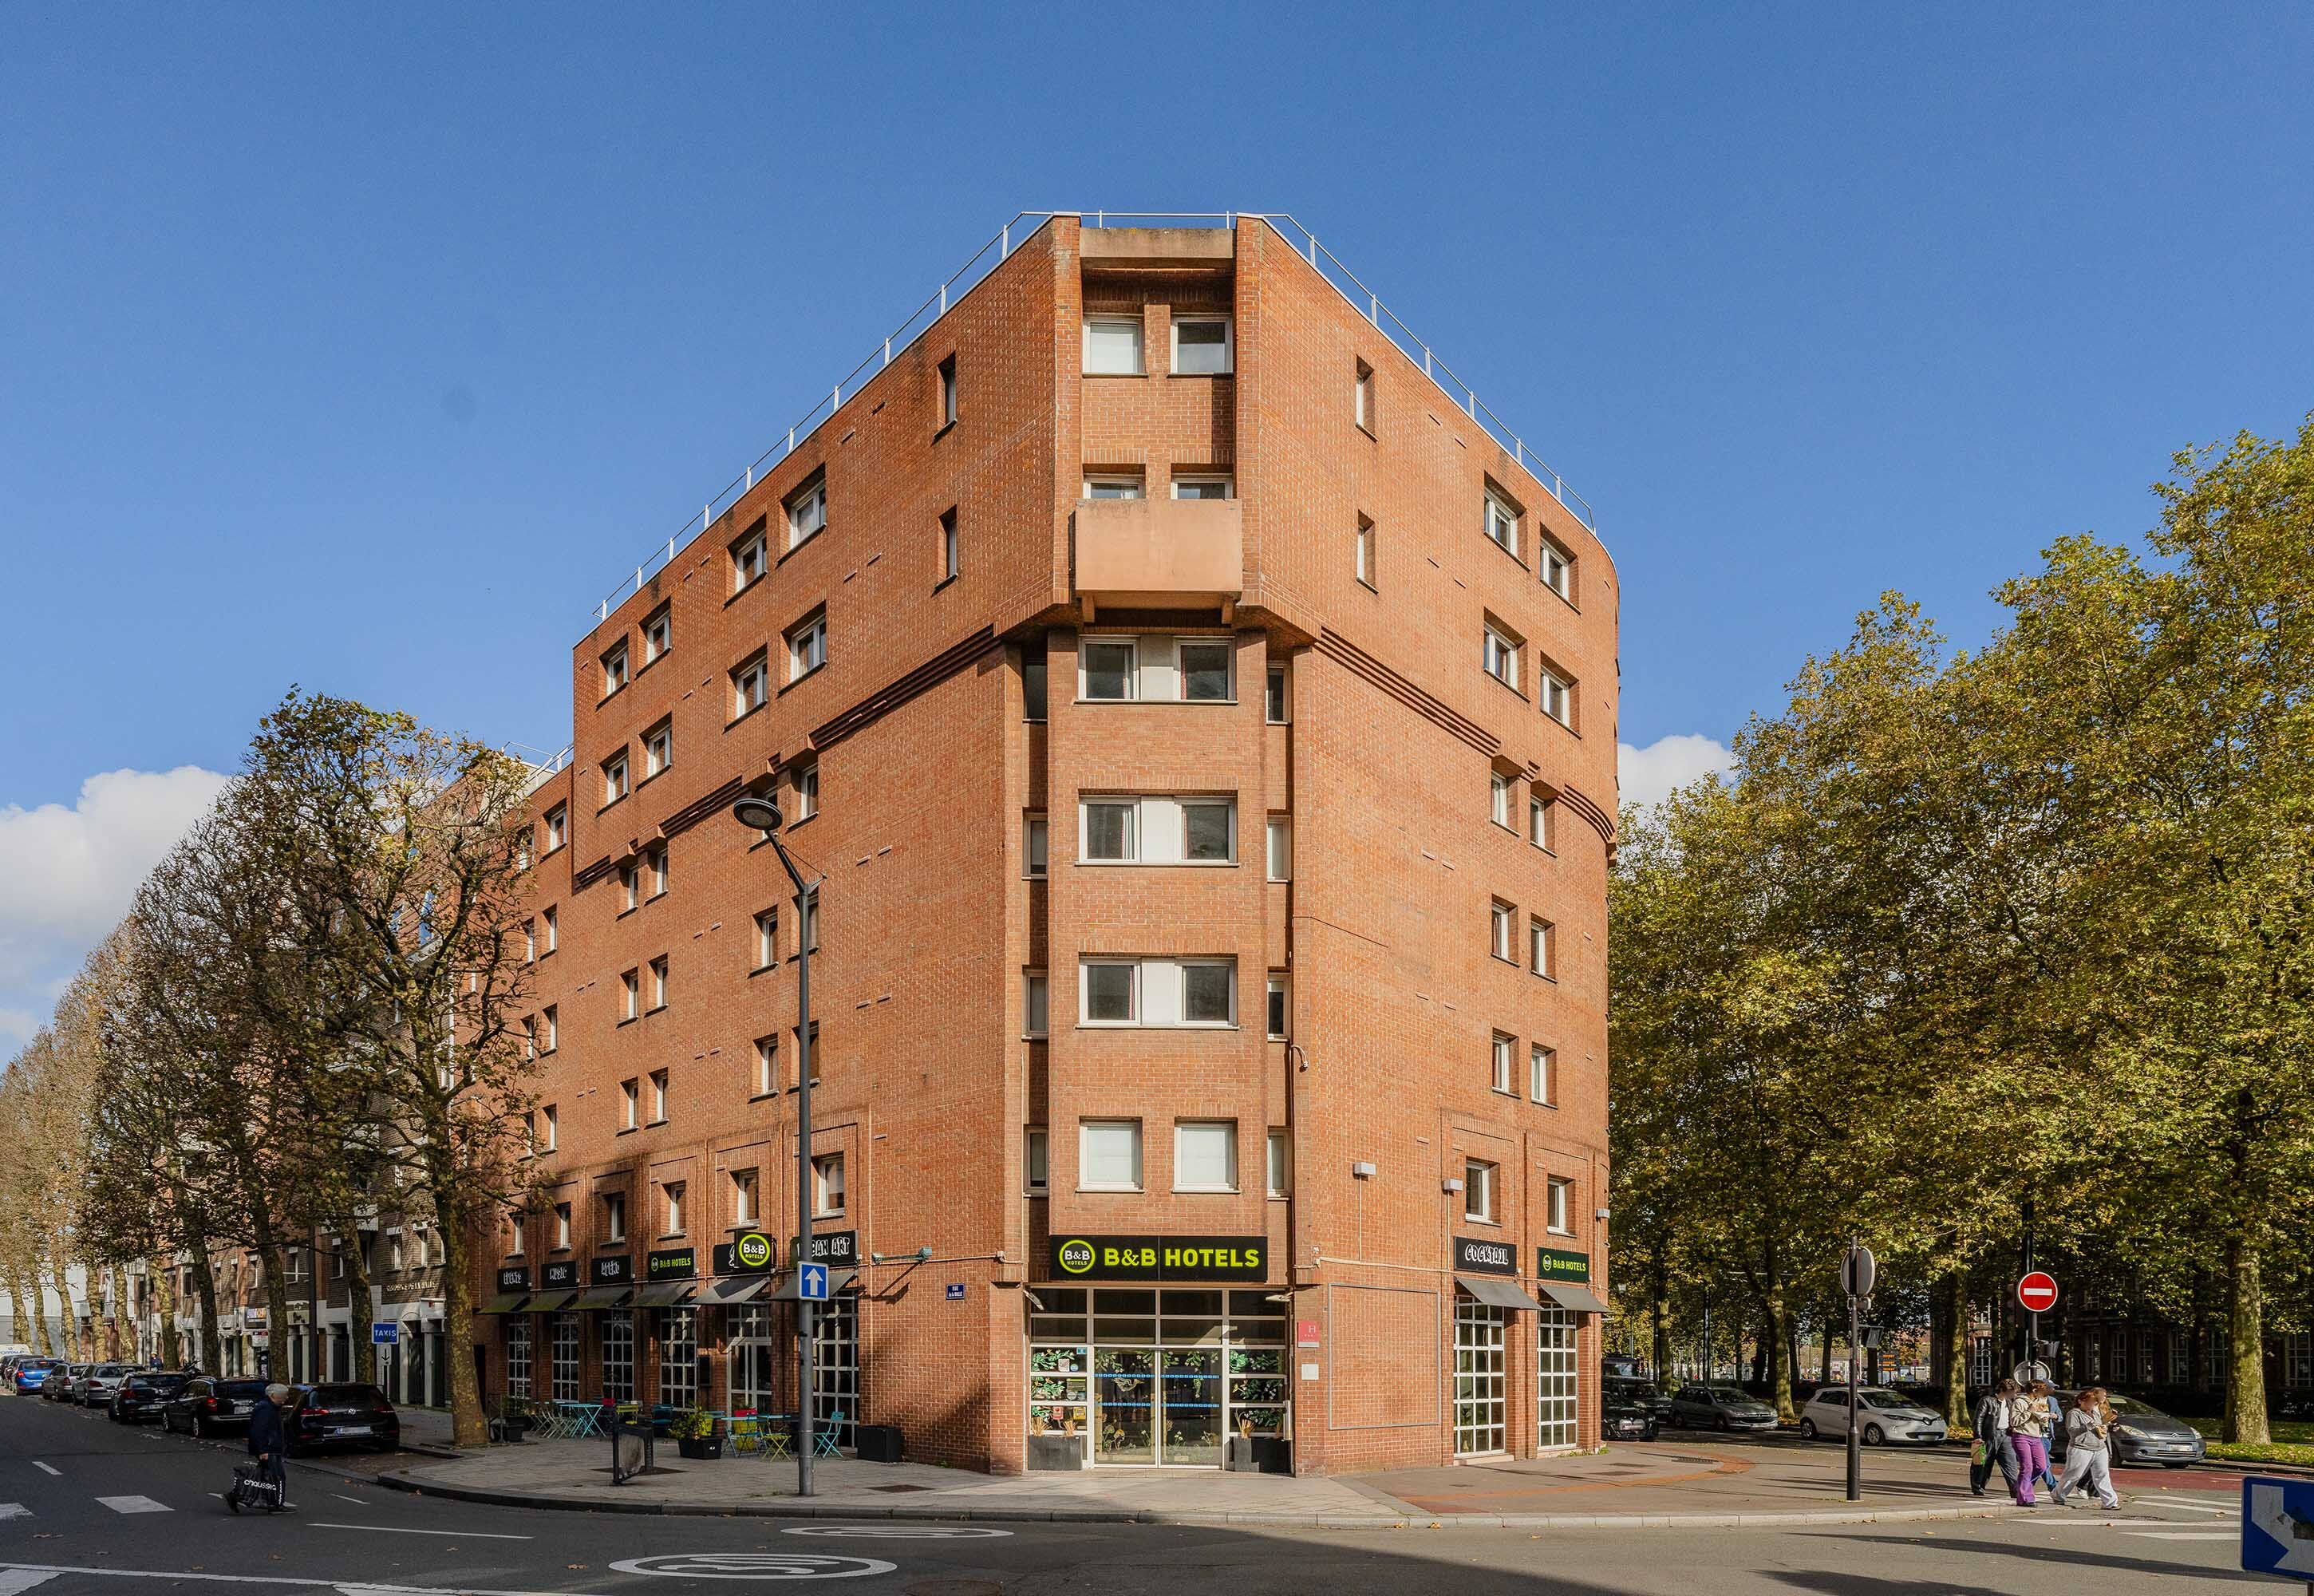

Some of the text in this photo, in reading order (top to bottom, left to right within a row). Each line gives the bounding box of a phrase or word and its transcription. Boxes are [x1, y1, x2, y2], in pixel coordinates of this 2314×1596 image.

[743, 1243, 766, 1254] B&B
[797, 1237, 851, 1257] BAN ART
[1064, 1250, 1090, 1260] B&B
[1104, 1248, 1259, 1267] B&B HOTELS
[1465, 1244, 1509, 1265] COCKTAIL
[660, 1259, 670, 1268] B&B
[671, 1258, 691, 1267] HOTELS
[1553, 1259, 1565, 1269] B&B
[1566, 1261, 1586, 1271] HOTELS
